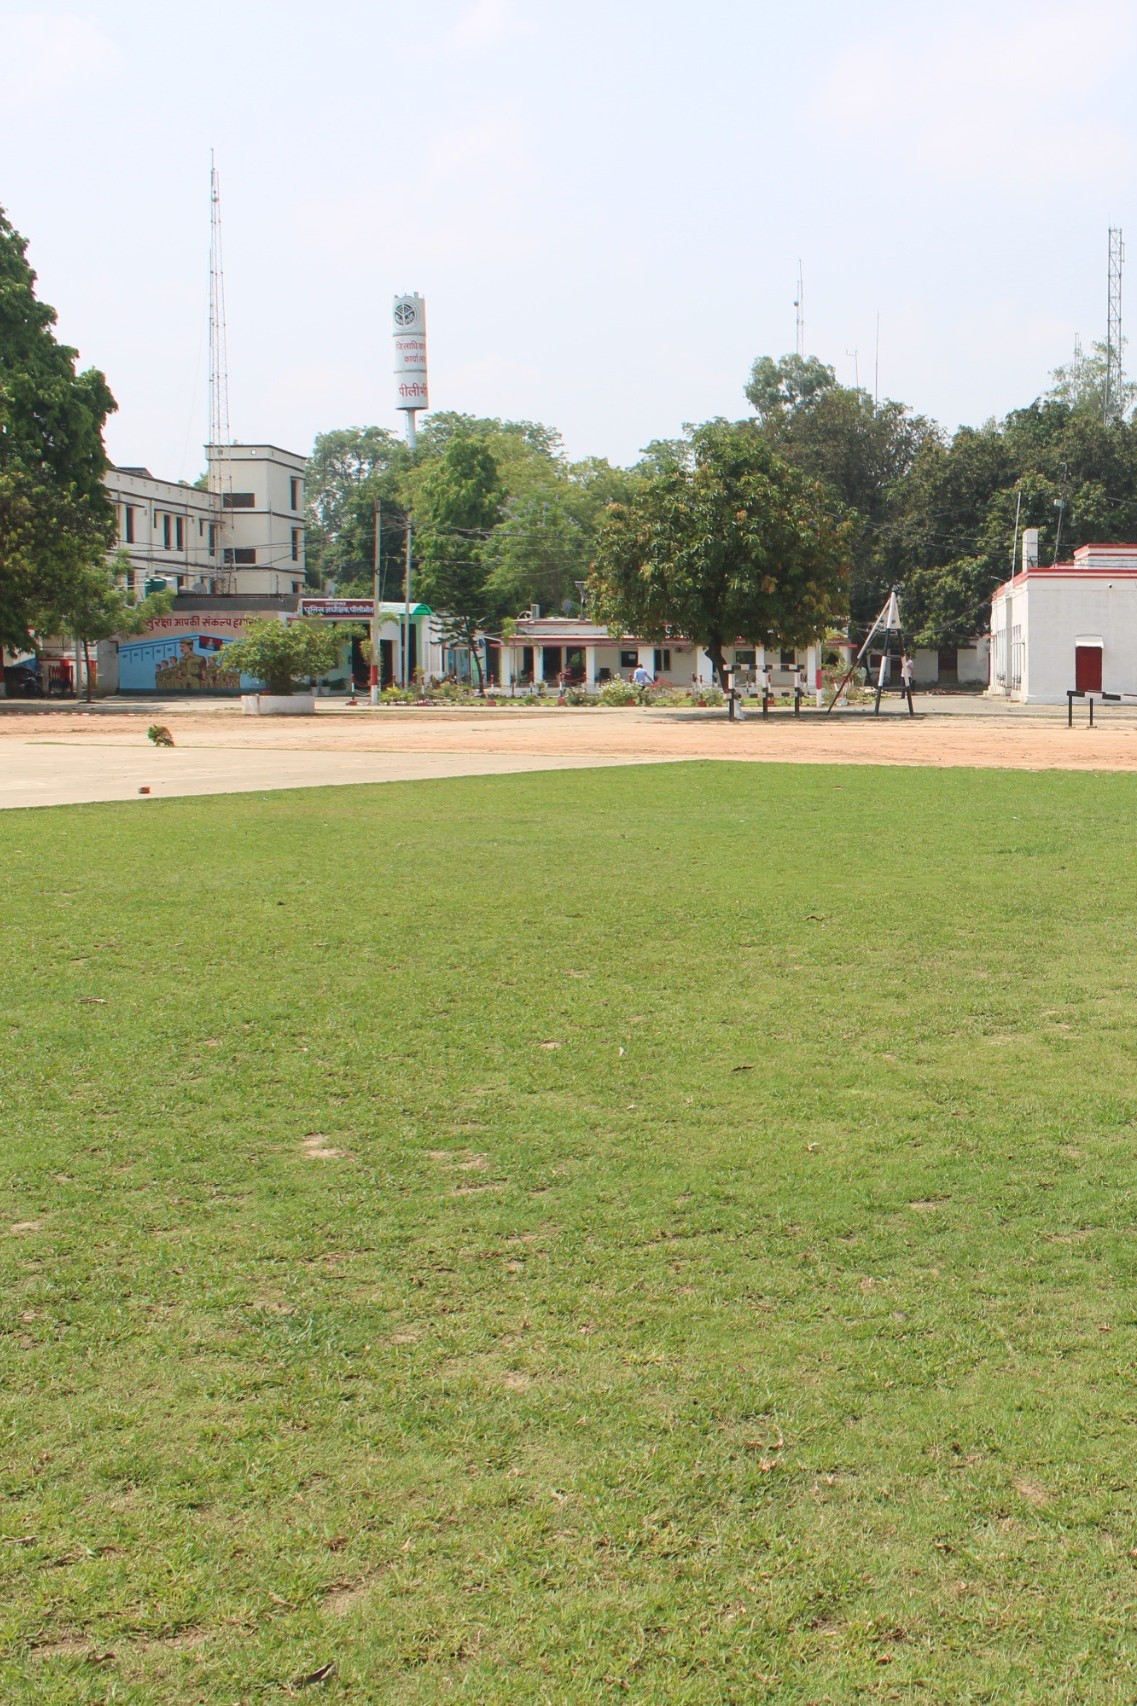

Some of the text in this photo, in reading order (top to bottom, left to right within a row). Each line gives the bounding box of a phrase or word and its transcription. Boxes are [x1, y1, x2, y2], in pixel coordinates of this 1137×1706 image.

[399, 382, 428, 397] पीलीभी
[174, 616, 200, 627] आपकी
[202, 616, 231, 627] संकल्प
